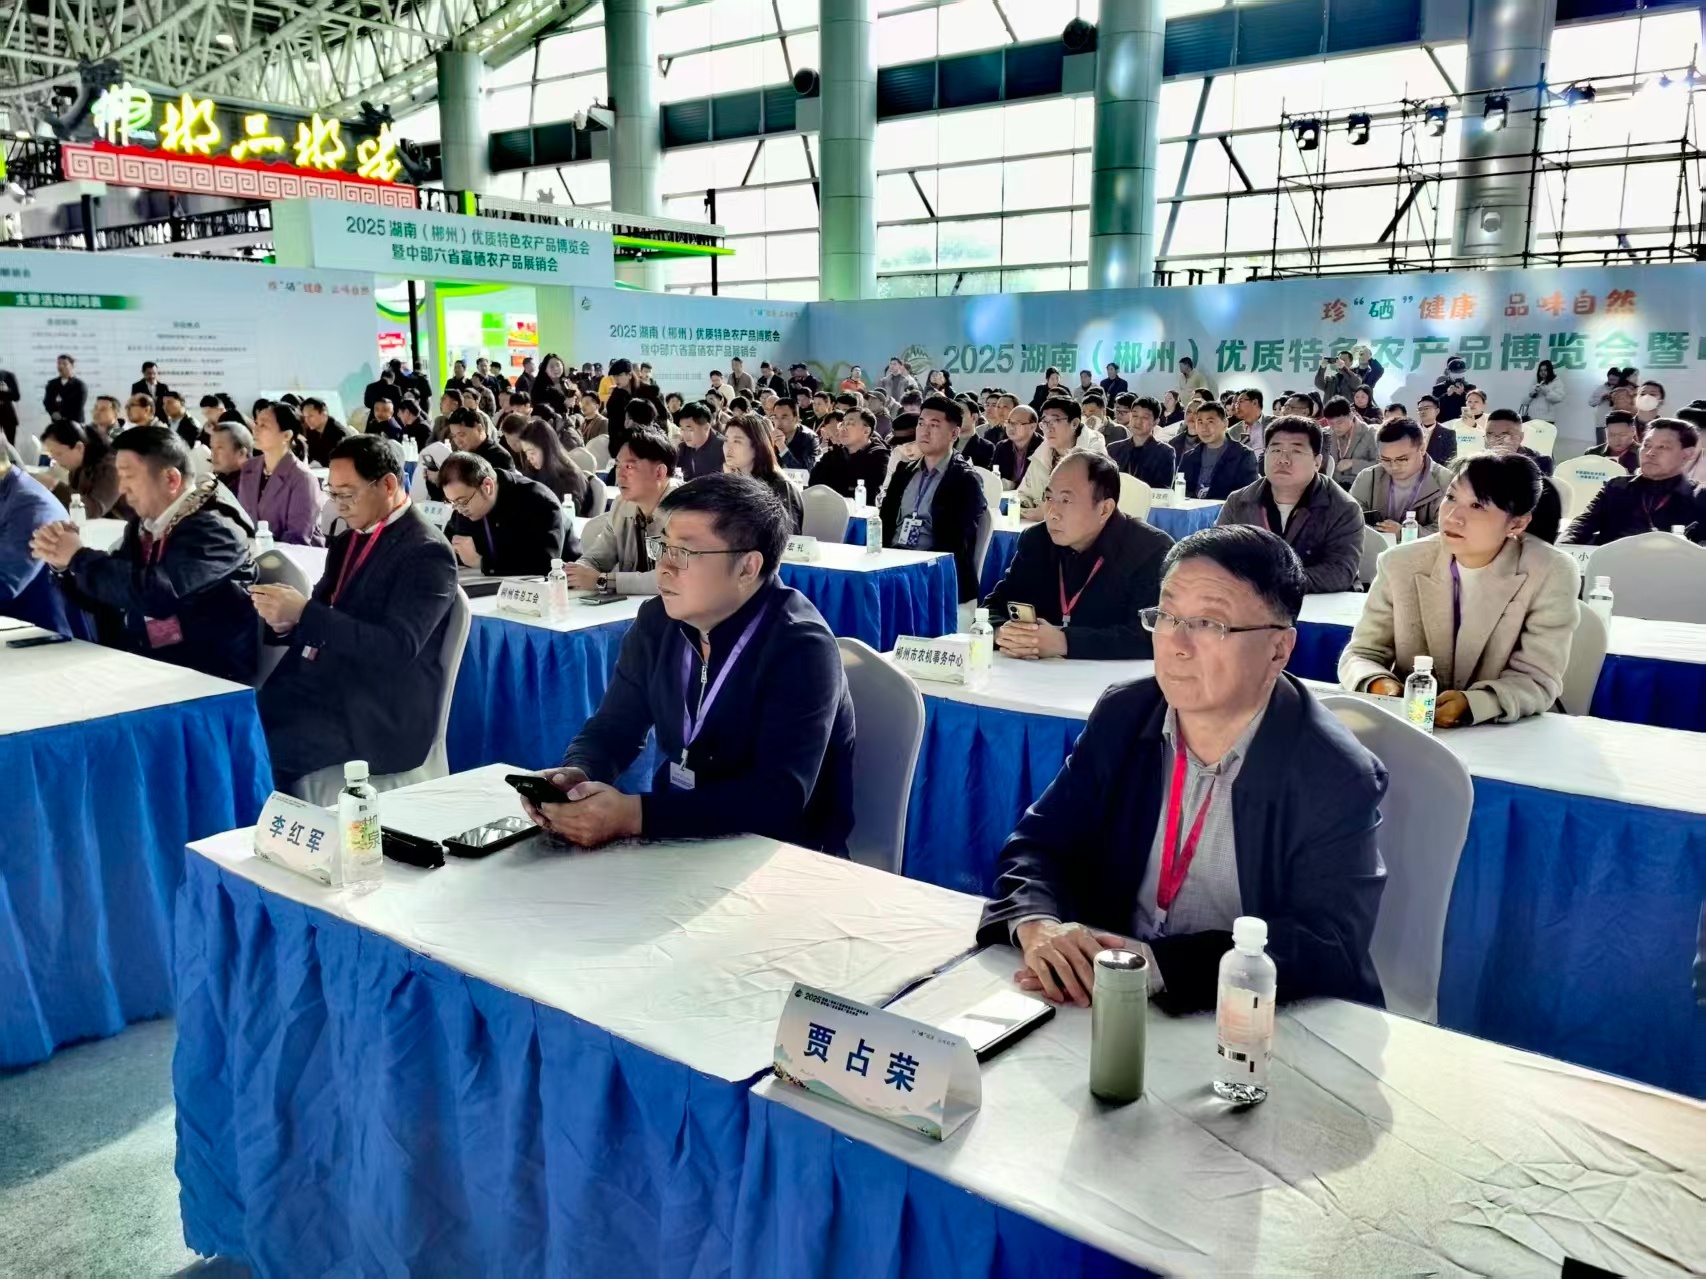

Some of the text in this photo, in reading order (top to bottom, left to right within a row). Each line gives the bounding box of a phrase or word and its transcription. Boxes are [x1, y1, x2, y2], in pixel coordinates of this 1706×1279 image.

[346, 216, 590, 256] 2025湖南（郴州）优质特色农产品博览会
[391, 243, 558, 273] 暨中部六省富硒农产品展销会
[1504, 289, 1638, 316] 品味自然
[943, 330, 1706, 375] 2025湖南（郴州）优质特色农产品博览会暨
[895, 646, 964, 667] 郴州市农机事务中心
[269, 814, 326, 853] 李红军
[801, 1021, 921, 1094] 贾占荣
